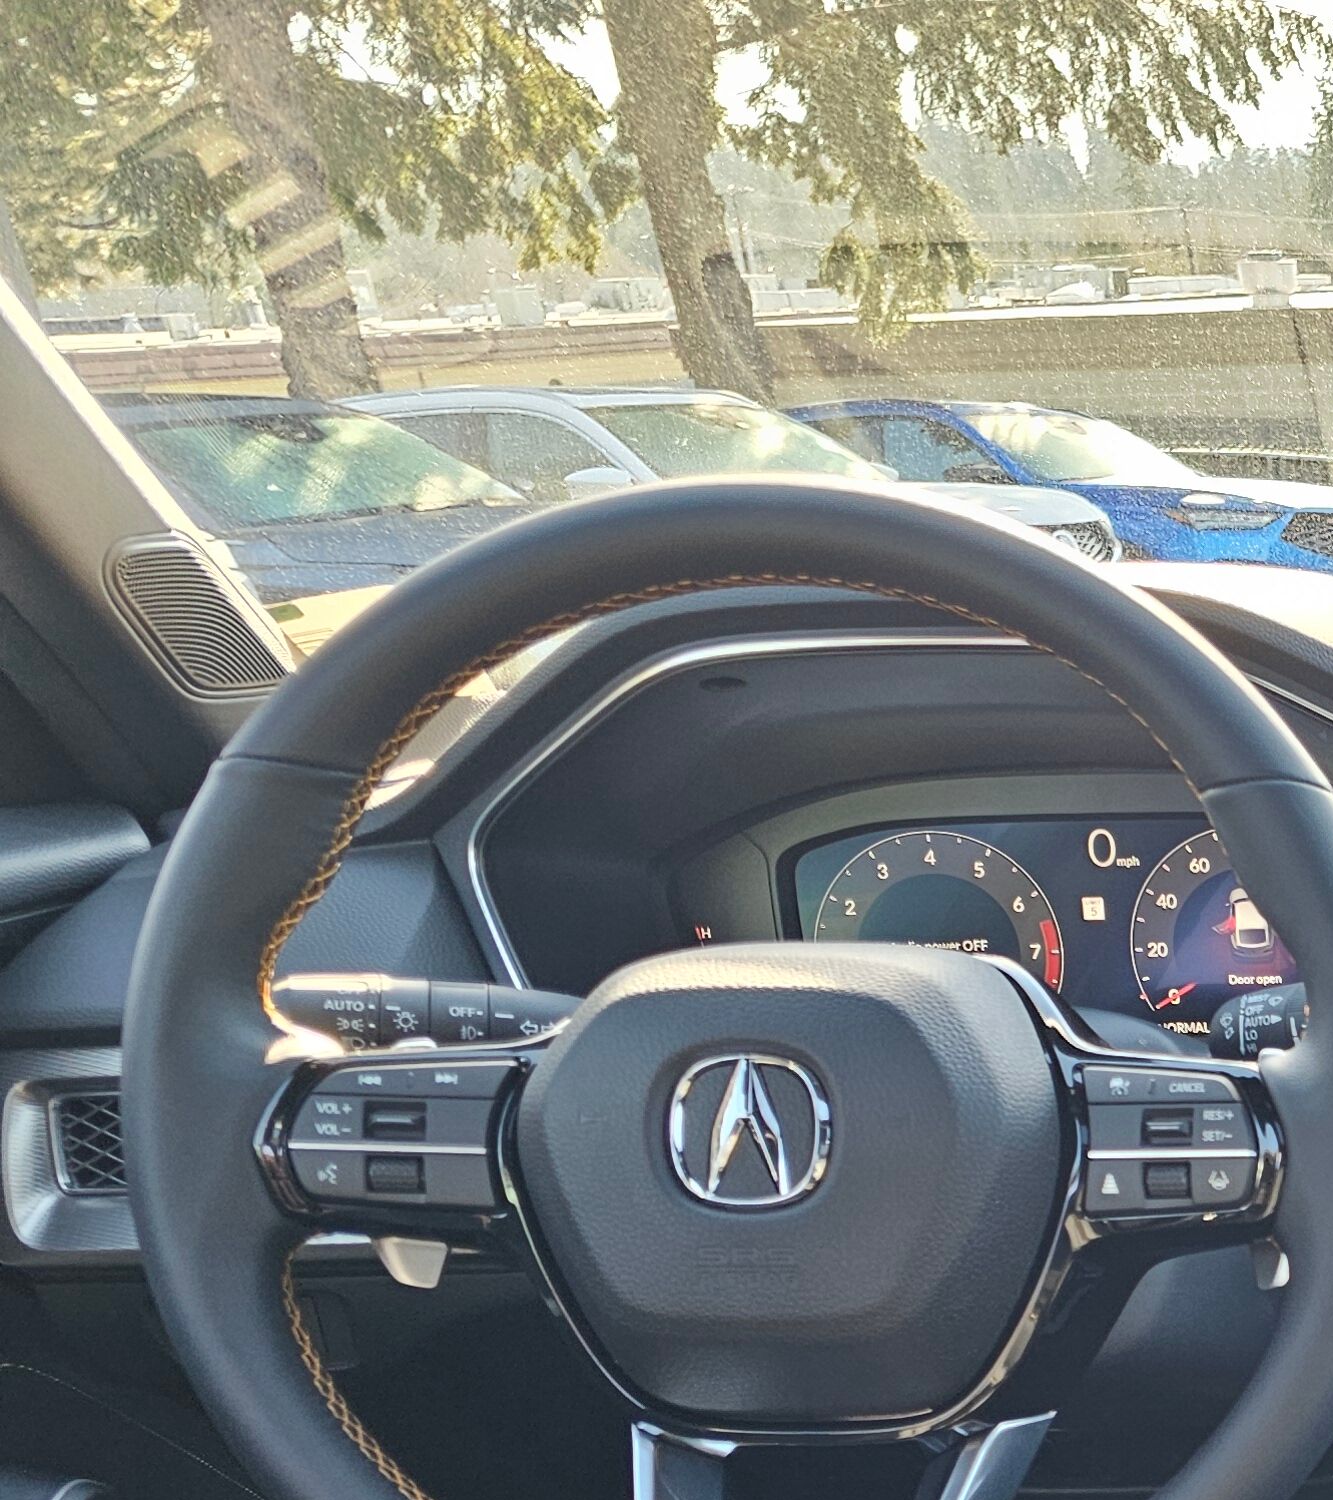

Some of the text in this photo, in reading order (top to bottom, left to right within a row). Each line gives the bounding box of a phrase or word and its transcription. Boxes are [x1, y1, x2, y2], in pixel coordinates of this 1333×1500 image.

[1088, 828, 1141, 869] 0 mph
[924, 849, 937, 866] 4
[1189, 857, 1211, 874] 60
[877, 863, 889, 880] 3
[973, 861, 986, 879] 5
[844, 899, 857, 916] 2
[1012, 896, 1025, 913] 6
[1155, 893, 1178, 910] 40
[962, 939, 989, 952] OFF
[1029, 943, 1042, 960] 7
[1147, 942, 1169, 958] 20
[1228, 974, 1283, 987] Door open
[324, 999, 365, 1012] AUTO
[449, 1006, 475, 1018] OFF
[1245, 1004, 1264, 1016] OFF
[1245, 1015, 1271, 1027] AUTO
[1245, 1030, 1258, 1041] LO
[1169, 1082, 1206, 1093] CANCEL
